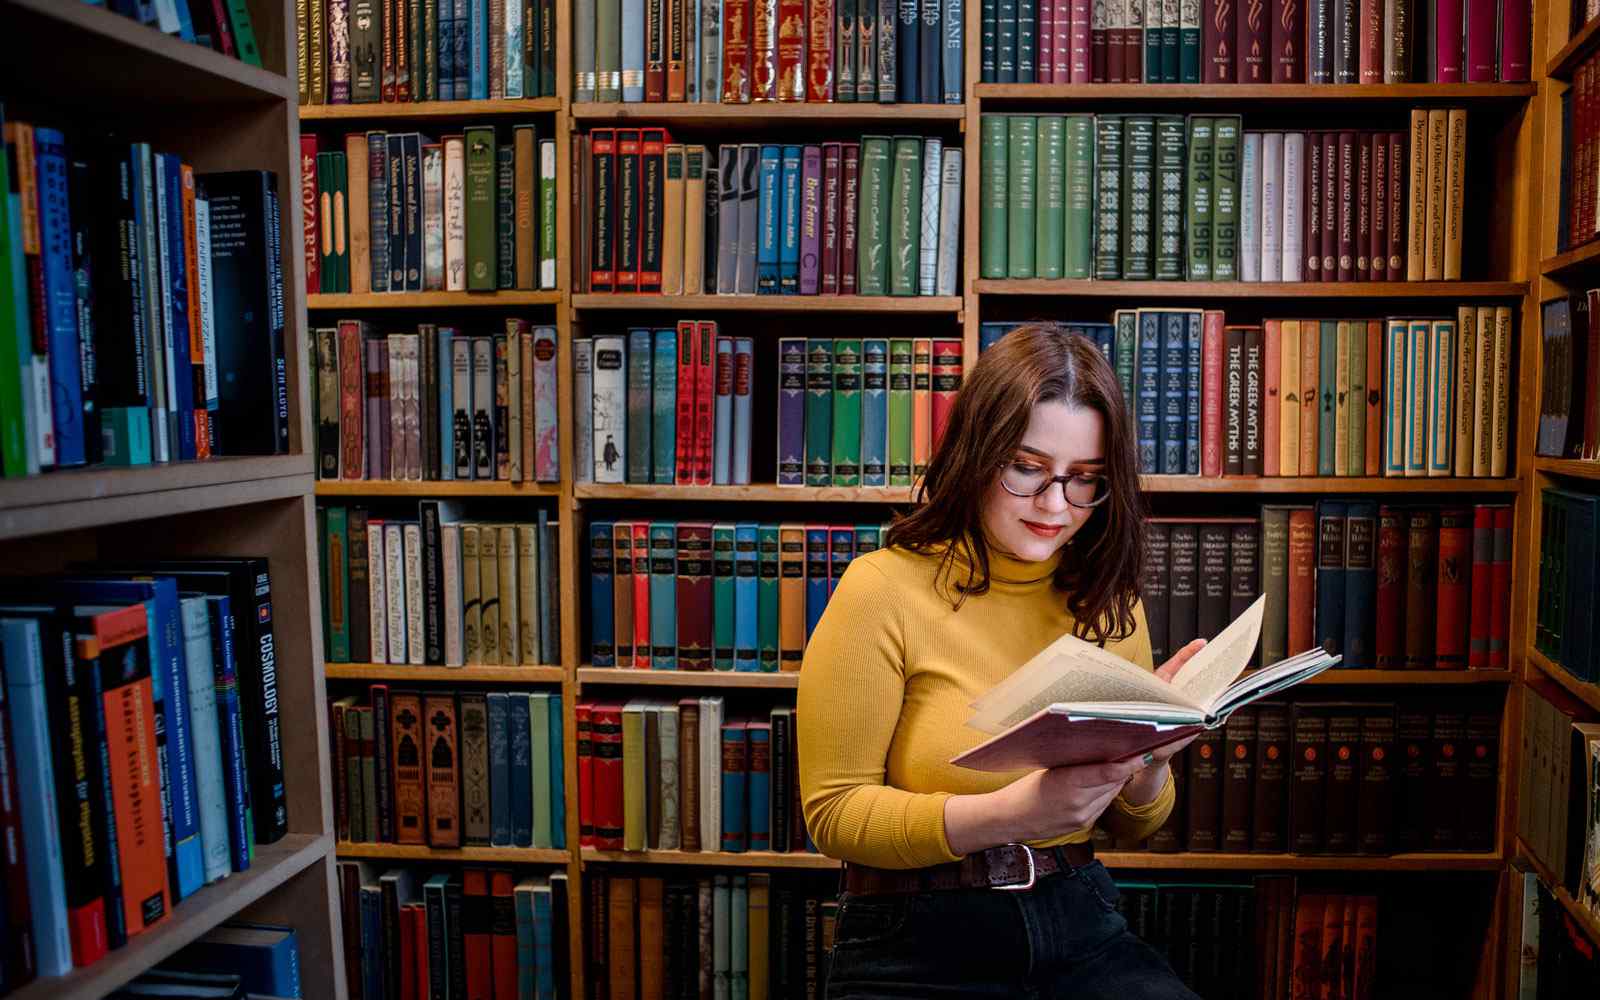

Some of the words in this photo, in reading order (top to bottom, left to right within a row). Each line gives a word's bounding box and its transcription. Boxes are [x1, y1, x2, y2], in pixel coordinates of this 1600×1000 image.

[1432, 119, 1443, 144] Early
[1193, 145, 1210, 183] 1914
[1219, 145, 1235, 183] 1917
[1343, 144, 1352, 179] HISTORY
[1392, 144, 1401, 179] HISTORY
[1453, 151, 1462, 168] Art
[827, 178, 836, 190] The
[847, 178, 857, 190] The
[1327, 180, 1335, 200] AND
[1343, 181, 1352, 200] AND
[1377, 180, 1385, 200] AND
[1392, 181, 1401, 200] AND
[1415, 167, 1424, 184] Art
[1452, 170, 1461, 188] and
[1312, 185, 1320, 204] AND
[1361, 185, 1369, 204] AND
[1415, 187, 1424, 204] and
[1434, 185, 1442, 202] Art
[197, 211, 206, 234] THE
[303, 171, 317, 259] MOZART
[1327, 201, 1335, 231] SAINTS
[1343, 202, 1352, 242] ROMANCE
[1377, 201, 1385, 231] SAINTS
[1392, 202, 1401, 242] ROMANCE
[1433, 204, 1441, 220] and
[1192, 222, 1209, 259] 1916
[1217, 222, 1234, 259] 1919
[199, 240, 209, 298] INFINITY
[202, 301, 212, 353] PUZZLE
[276, 358, 285, 384] SETH
[1229, 345, 1240, 369] THE
[1248, 345, 1258, 369] THE
[278, 386, 288, 419] LLOYD
[1229, 371, 1240, 405] GREEK
[1247, 371, 1258, 405] GREEK
[1229, 408, 1240, 450] MYTHS
[1247, 408, 1258, 450] MYTHS
[1229, 455, 1238, 463] II
[171, 656, 179, 674] THE
[260, 633, 278, 715] COSMOLOGY
[173, 676, 183, 724] PRIMORDIAL
[121, 688, 135, 745] Modern
[68, 696, 87, 780] Astrophysics
[177, 726, 186, 762] DENSITY
[75, 781, 89, 800] for
[127, 751, 145, 847] Astrophysics
[179, 764, 192, 826] PERTURBATION
[79, 801, 96, 867] Physicists
